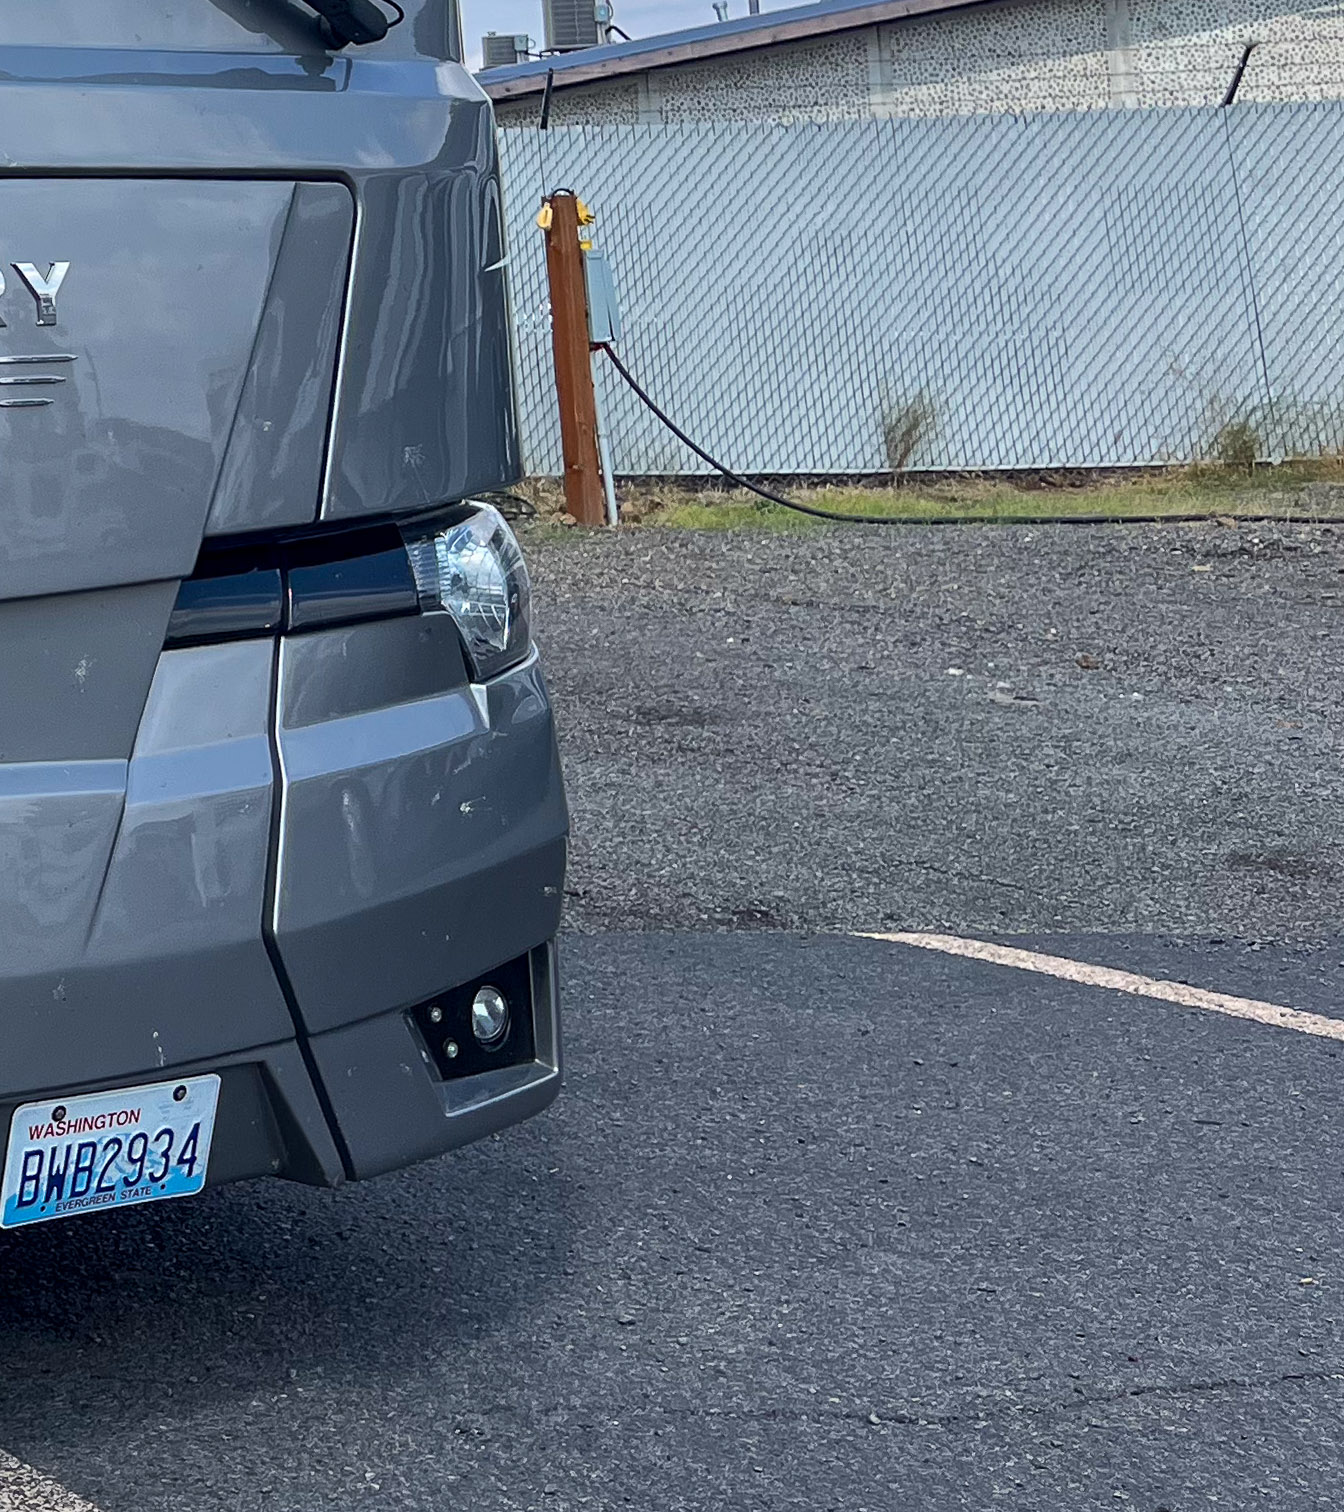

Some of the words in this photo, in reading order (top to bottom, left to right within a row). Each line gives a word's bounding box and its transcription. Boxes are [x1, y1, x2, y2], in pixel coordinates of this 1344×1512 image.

[28, 1108, 142, 1141] WASHINGTON
[15, 1122, 201, 1209] BWB2934
[54, 1193, 116, 1213] EVERGREEN
[120, 1187, 152, 1200] STATE
